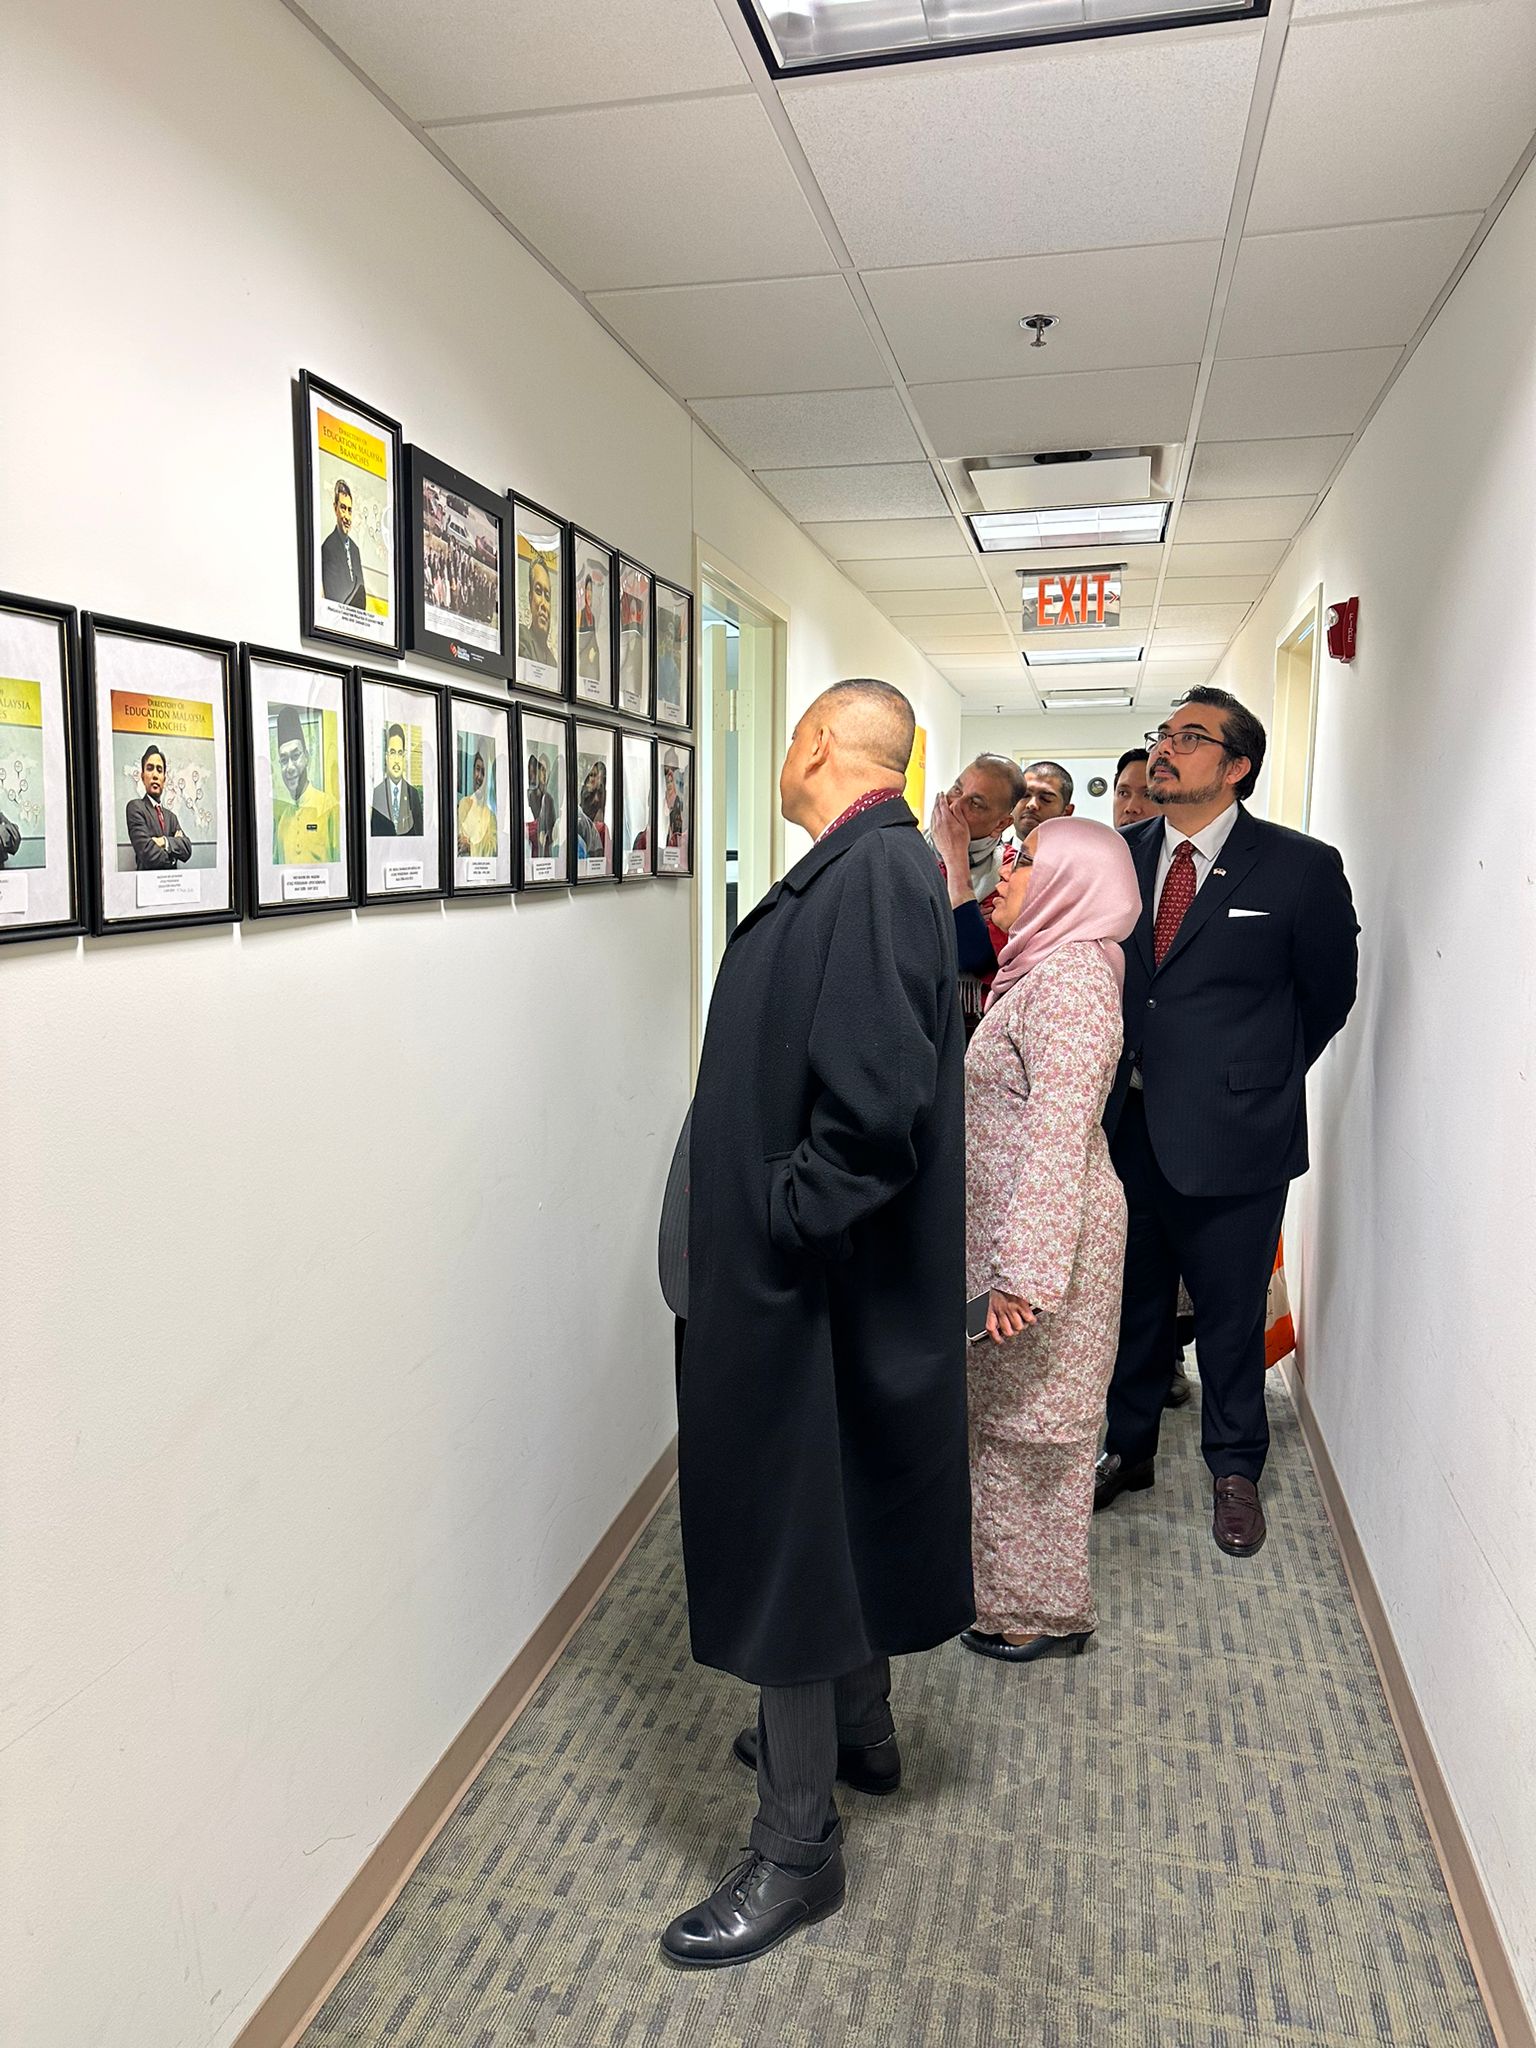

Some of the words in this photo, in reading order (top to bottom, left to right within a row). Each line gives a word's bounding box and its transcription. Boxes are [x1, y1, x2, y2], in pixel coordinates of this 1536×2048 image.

[1036, 573, 1111, 627] EXIT
[124, 704, 170, 719] EDUCATION
[171, 709, 206, 723] MALAYSIA
[147, 718, 187, 732] BRANCHES
